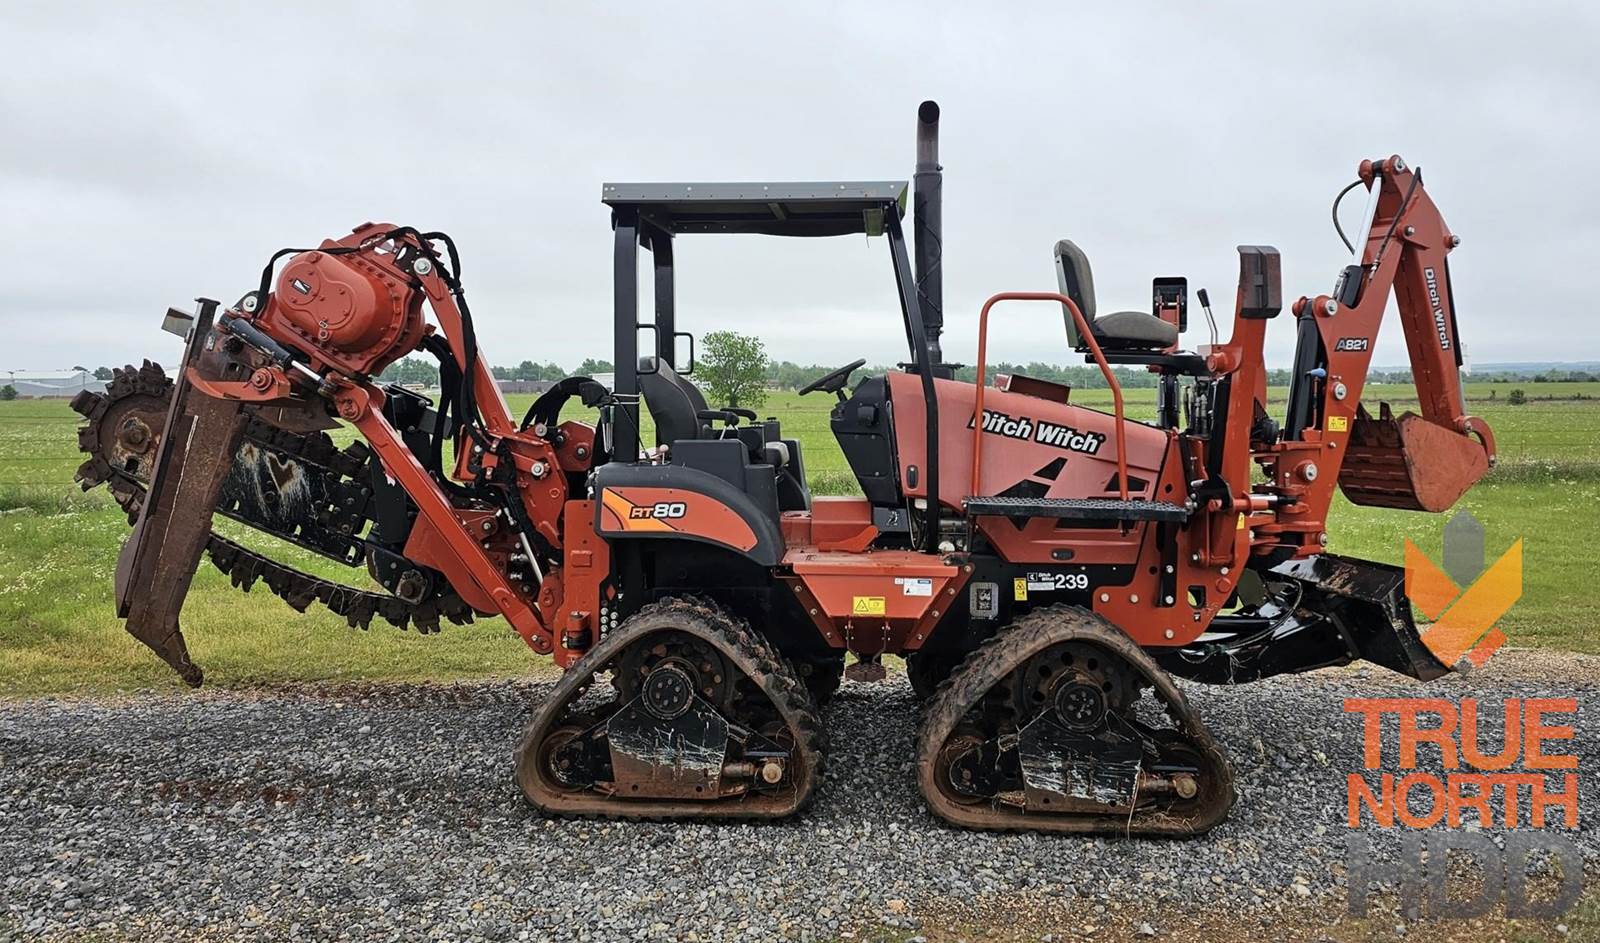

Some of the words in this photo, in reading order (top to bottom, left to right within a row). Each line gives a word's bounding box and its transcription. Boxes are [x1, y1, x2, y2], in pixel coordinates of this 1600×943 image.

[1424, 268, 1440, 306] Ditch
[1434, 308, 1450, 350] Witch
[1336, 339, 1368, 351] A821
[1036, 423, 1100, 453] Witch
[631, 503, 686, 518] RT80
[1055, 574, 1088, 589] 239
